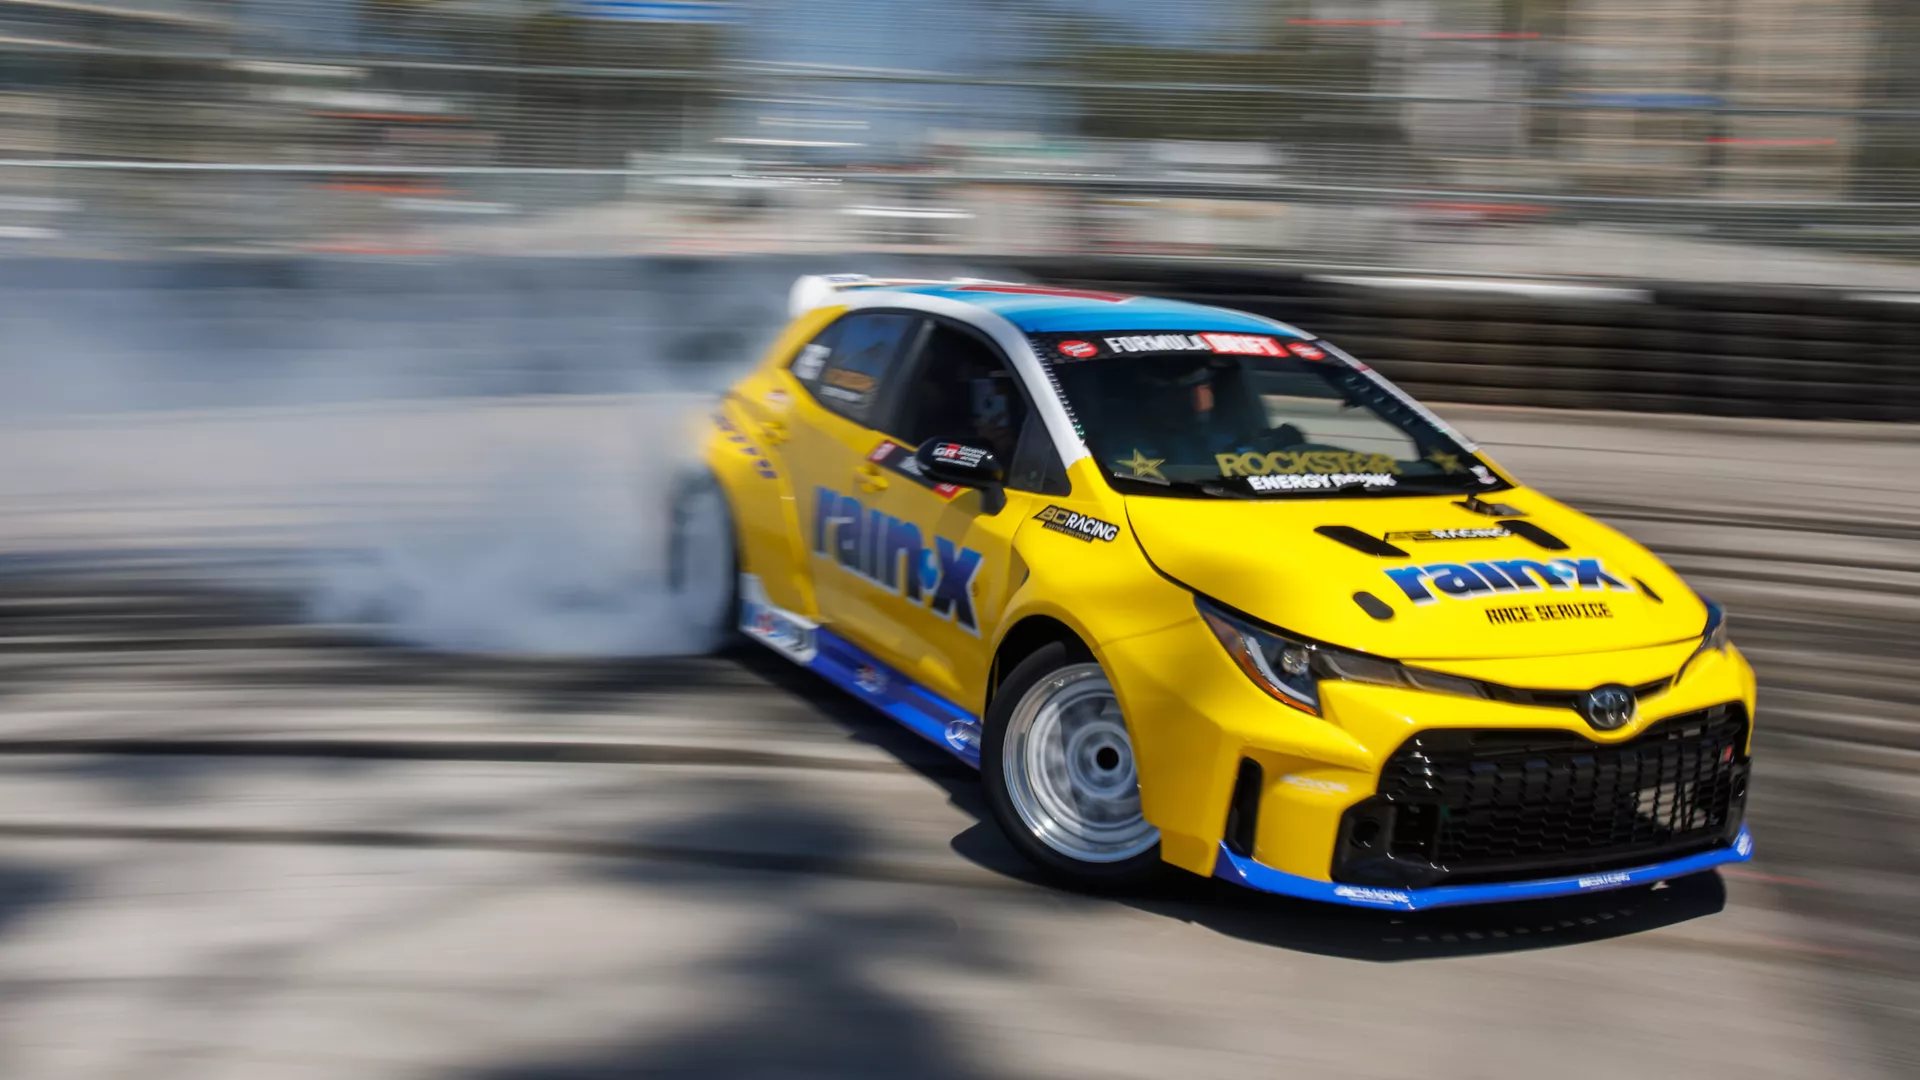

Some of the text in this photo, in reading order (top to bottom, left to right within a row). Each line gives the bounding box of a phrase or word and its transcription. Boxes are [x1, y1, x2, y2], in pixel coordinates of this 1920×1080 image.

[1104, 334, 1211, 353] FORMULA
[1203, 334, 1280, 356] DRIFT
[932, 447, 959, 458] GR
[1247, 474, 1332, 490] ENERGY
[1485, 602, 1614, 625] RACE SERVICE
